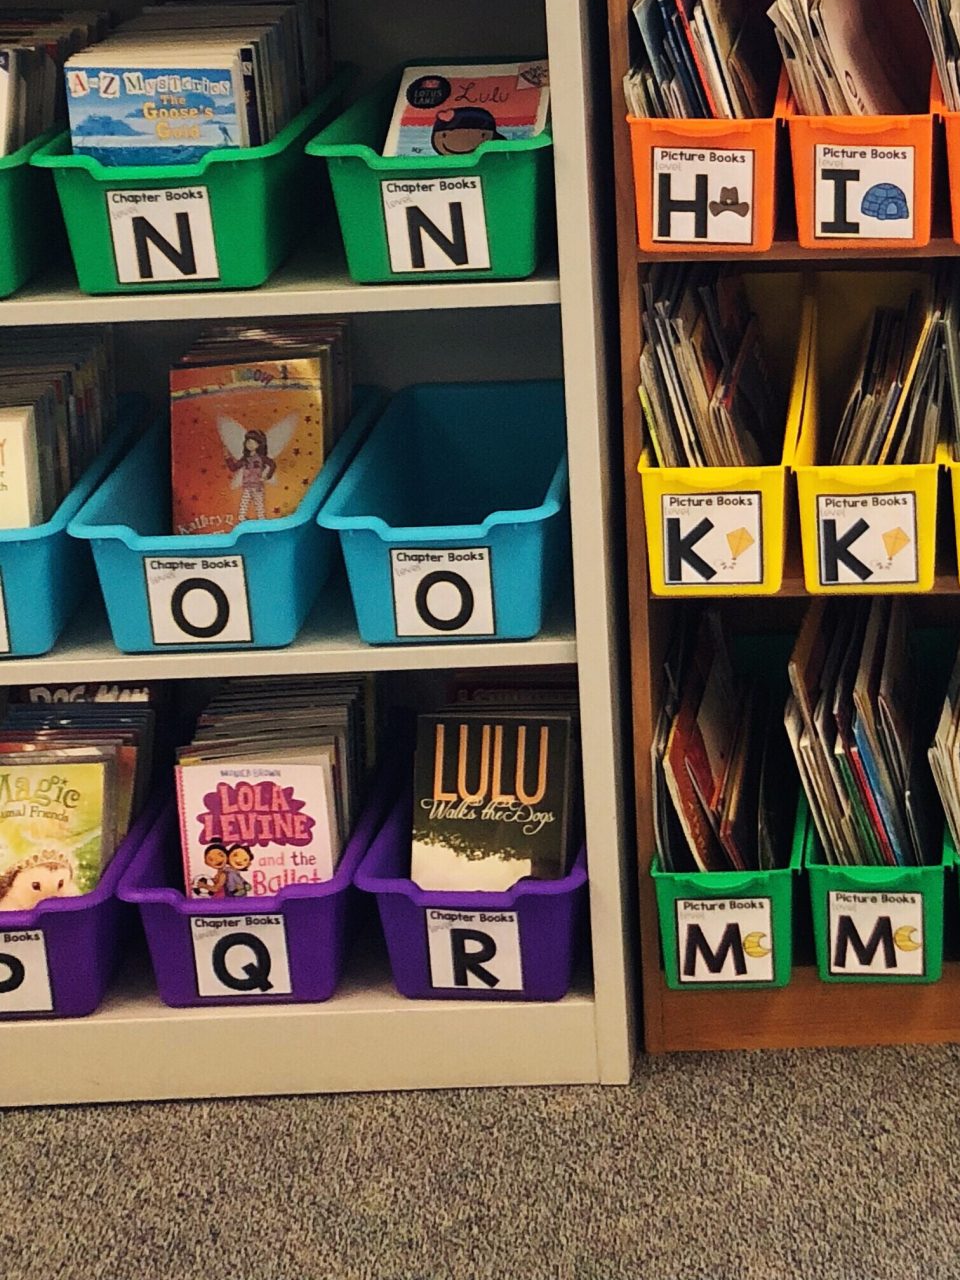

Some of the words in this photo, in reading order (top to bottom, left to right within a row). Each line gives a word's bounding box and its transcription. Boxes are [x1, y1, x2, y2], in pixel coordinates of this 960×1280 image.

[454, 82, 510, 104] Lulu
[143, 103, 214, 120] Goose's
[660, 151, 706, 162] Picture
[709, 152, 746, 164] Books
[823, 148, 867, 160] Picture
[870, 148, 907, 160] Books
[112, 191, 161, 205] Chapter
[165, 189, 204, 201] Books
[386, 181, 436, 194] Chapter
[439, 179, 477, 193] Books
[658, 172, 709, 238] H
[821, 168, 860, 234] I
[131, 211, 198, 280] N
[405, 201, 469, 269] N
[669, 496, 713, 508] Picture
[716, 496, 753, 507] Books
[824, 497, 868, 509] Picture
[871, 496, 907, 508] Books
[396, 551, 444, 564] Chapter
[447, 550, 485, 563] Books
[666, 517, 717, 582] K
[822, 517, 874, 582] K
[150, 559, 197, 572] Chapter
[201, 557, 239, 570] Books
[170, 576, 230, 639] O
[414, 569, 475, 632] O
[433, 723, 549, 806] LULU
[219, 784, 291, 815] LOLA
[420, 795, 485, 821] Walks
[203, 812, 311, 842] LEVINE
[258, 852, 285, 867] and
[290, 850, 317, 867] the
[683, 900, 725, 912] Picture
[729, 899, 764, 910] Books
[835, 893, 878, 904] Picture
[880, 893, 916, 904] Books
[194, 916, 241, 930] Chapter
[244, 915, 281, 927] Books
[429, 909, 476, 922] Chapter
[479, 911, 515, 923] Books
[3, 933, 41, 943] Books
[683, 923, 748, 977] M
[834, 915, 898, 969] M
[211, 931, 274, 993] Q
[449, 927, 500, 988] R
